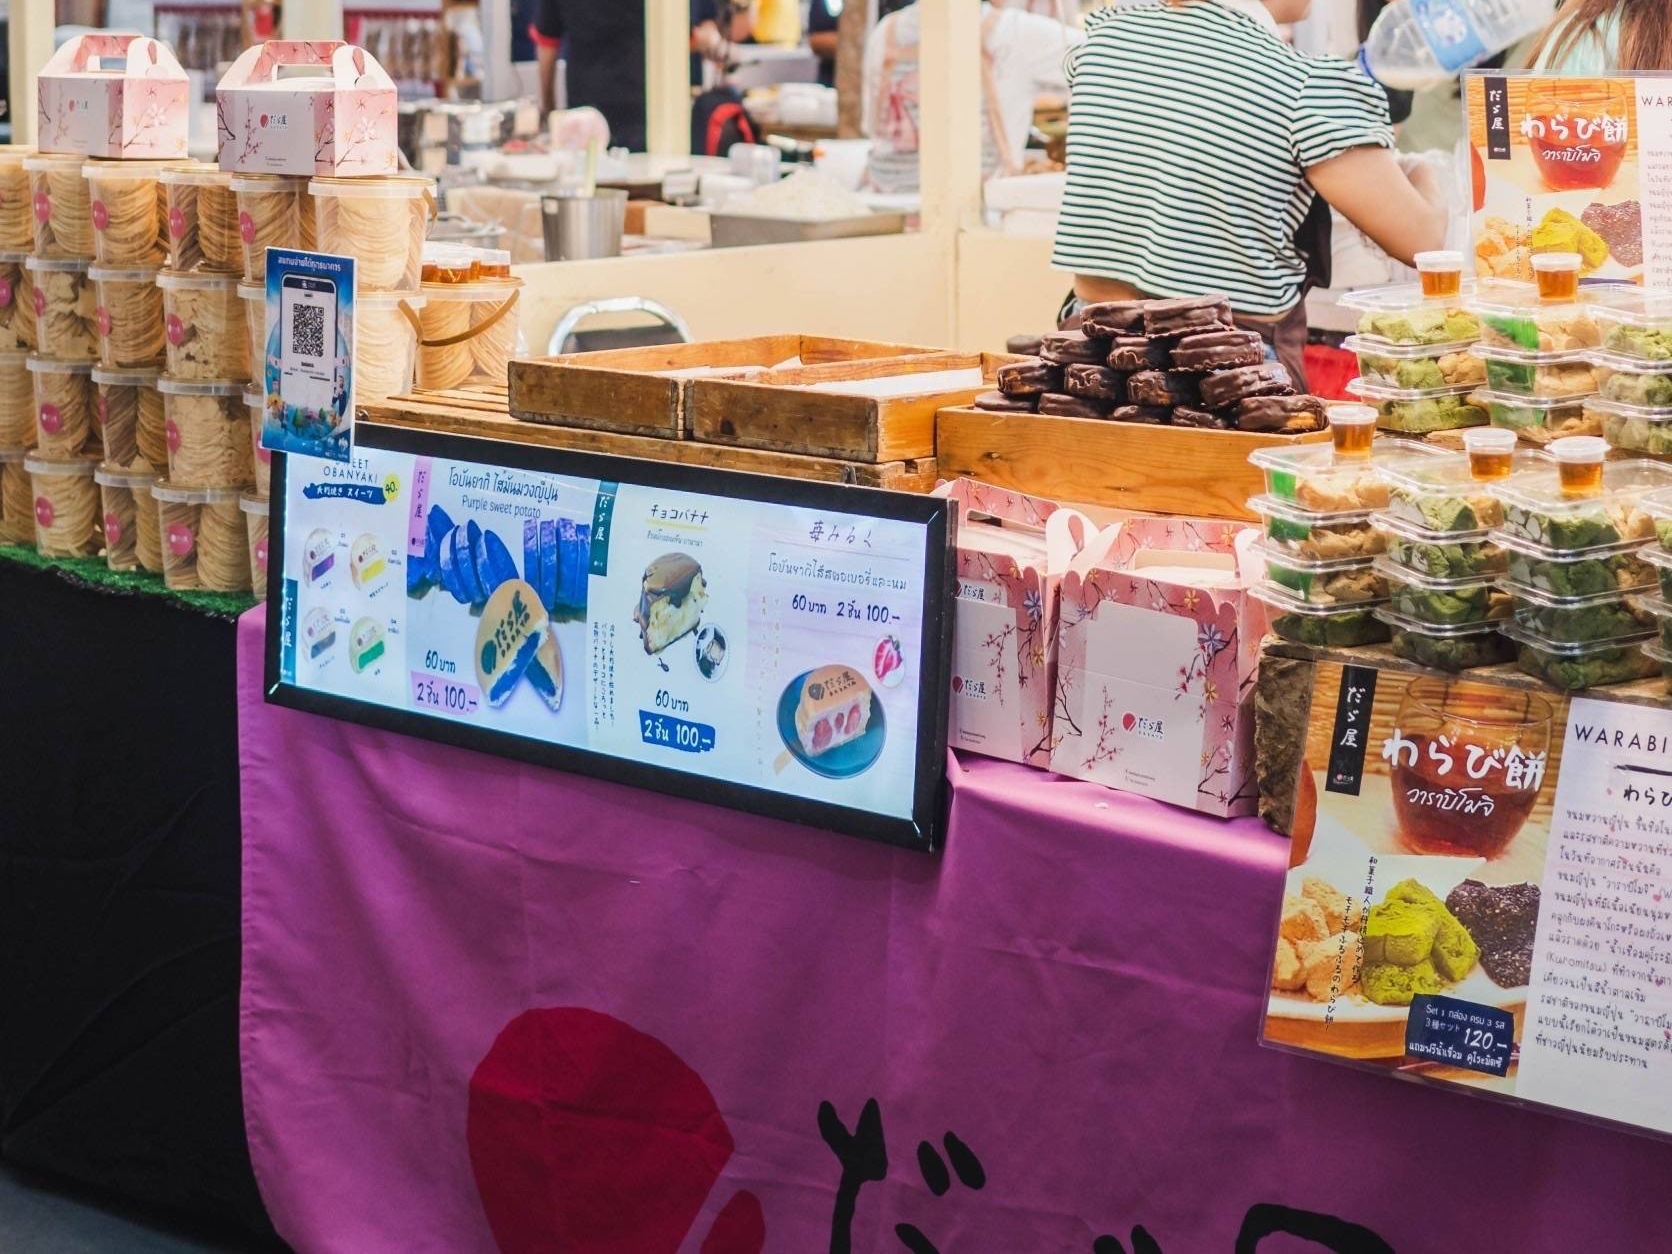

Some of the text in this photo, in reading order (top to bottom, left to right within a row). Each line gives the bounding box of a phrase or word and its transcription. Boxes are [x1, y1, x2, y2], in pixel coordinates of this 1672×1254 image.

[1520, 112, 1628, 143] わらび餅
[1542, 144, 1601, 163] วาราบิโมจิ
[323, 466, 378, 484] OBANYAKI
[335, 458, 369, 470] EET
[449, 466, 491, 491] โอบันยากิ
[462, 494, 541, 519] Purple sweet potato
[651, 504, 709, 525] チョコバナナ
[1575, 723, 1668, 754] WARABI
[1382, 728, 1547, 792] わらび餅
[1406, 787, 1496, 817] วาราบิโมจิ
[1426, 1004, 1438, 1015] Set
[1448, 1009, 1468, 1021] กล่อง
